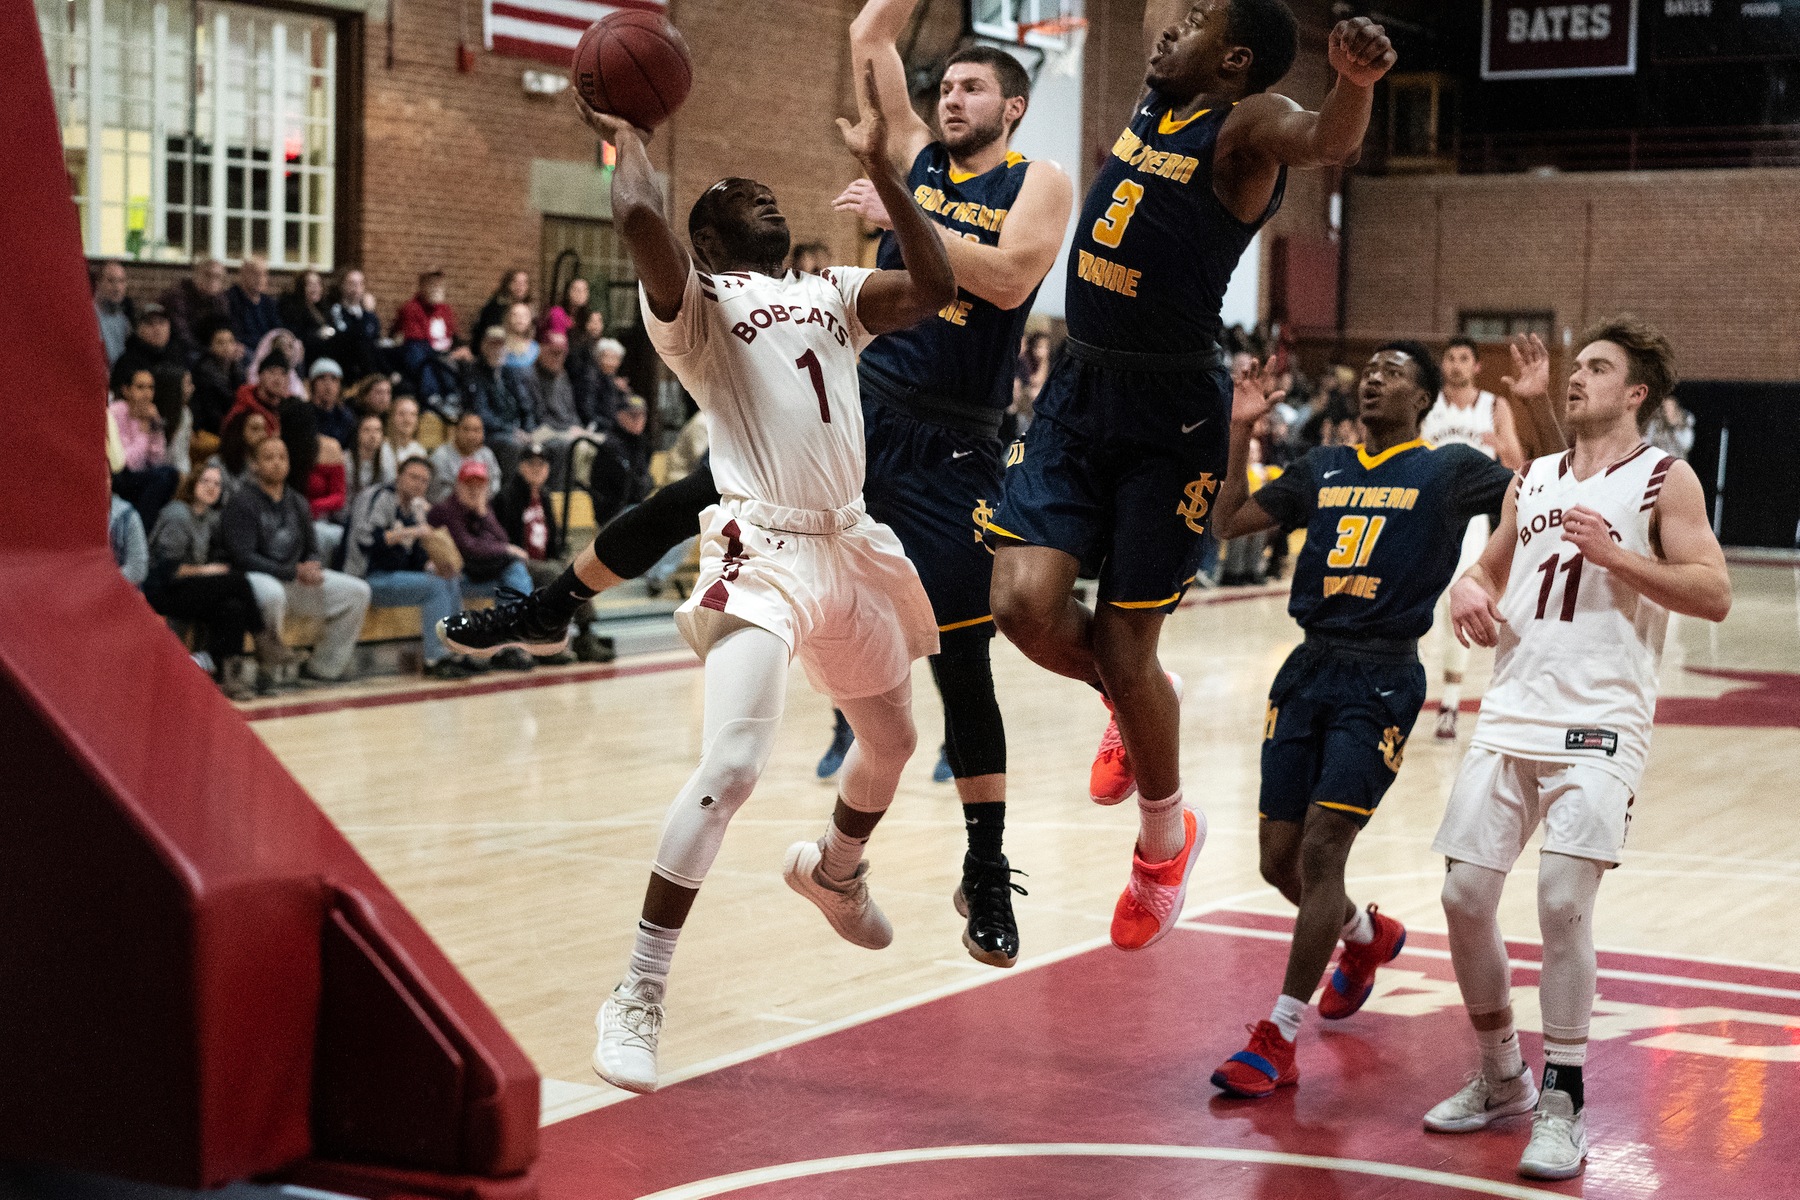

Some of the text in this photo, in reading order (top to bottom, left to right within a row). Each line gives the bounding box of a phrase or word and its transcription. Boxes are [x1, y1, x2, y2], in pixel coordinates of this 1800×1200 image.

[1507, 4, 1612, 42] BATES
[1092, 178, 1145, 249] 3
[1077, 249, 1142, 297] MAINE
[731, 304, 849, 347] BOBCATS
[795, 347, 831, 424] 1
[1318, 486, 1420, 510] SOUTHERN
[1327, 514, 1387, 568] 31
[1534, 552, 1584, 622] 11
